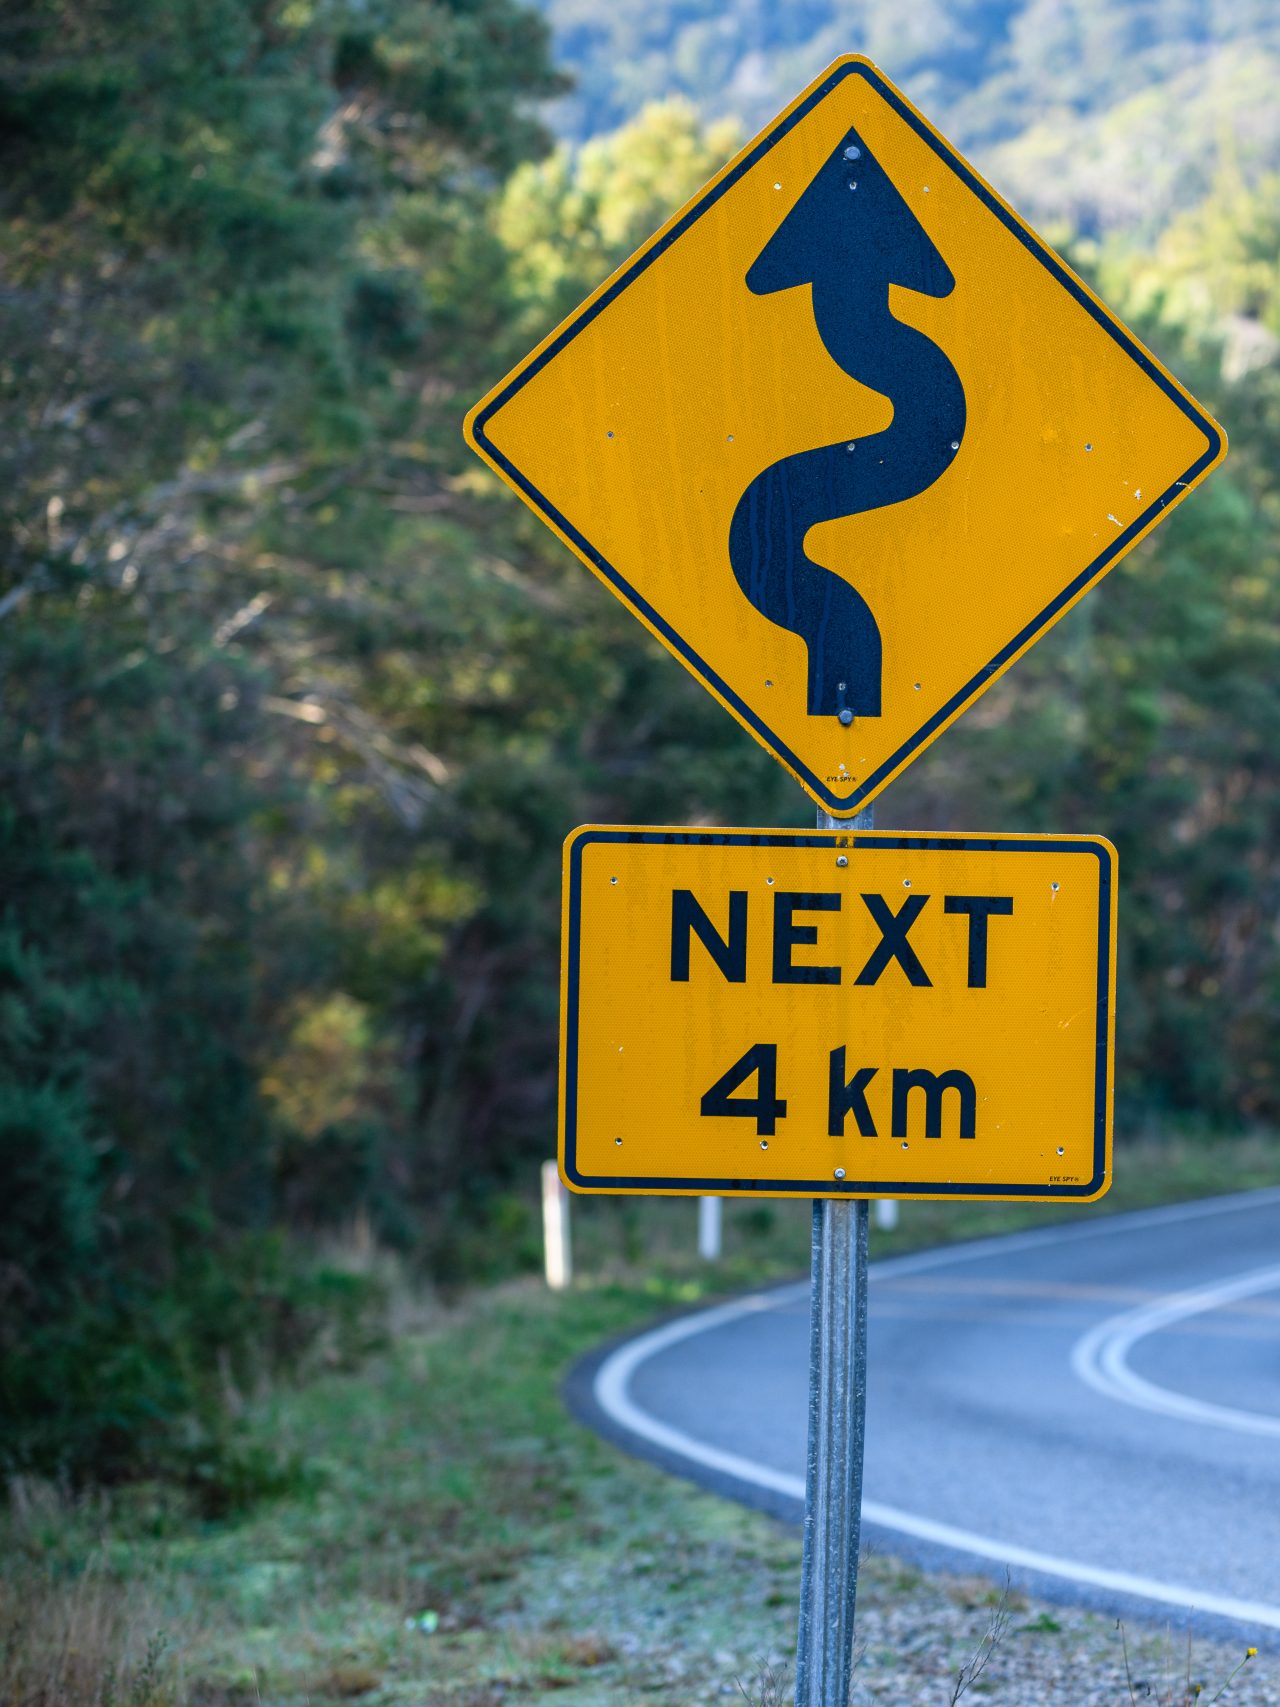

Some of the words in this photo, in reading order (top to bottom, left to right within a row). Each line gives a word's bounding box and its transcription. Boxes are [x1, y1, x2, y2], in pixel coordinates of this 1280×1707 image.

[670, 889, 1014, 989] NEXT
[700, 1043, 788, 1137] 4
[827, 1044, 978, 1140] km
